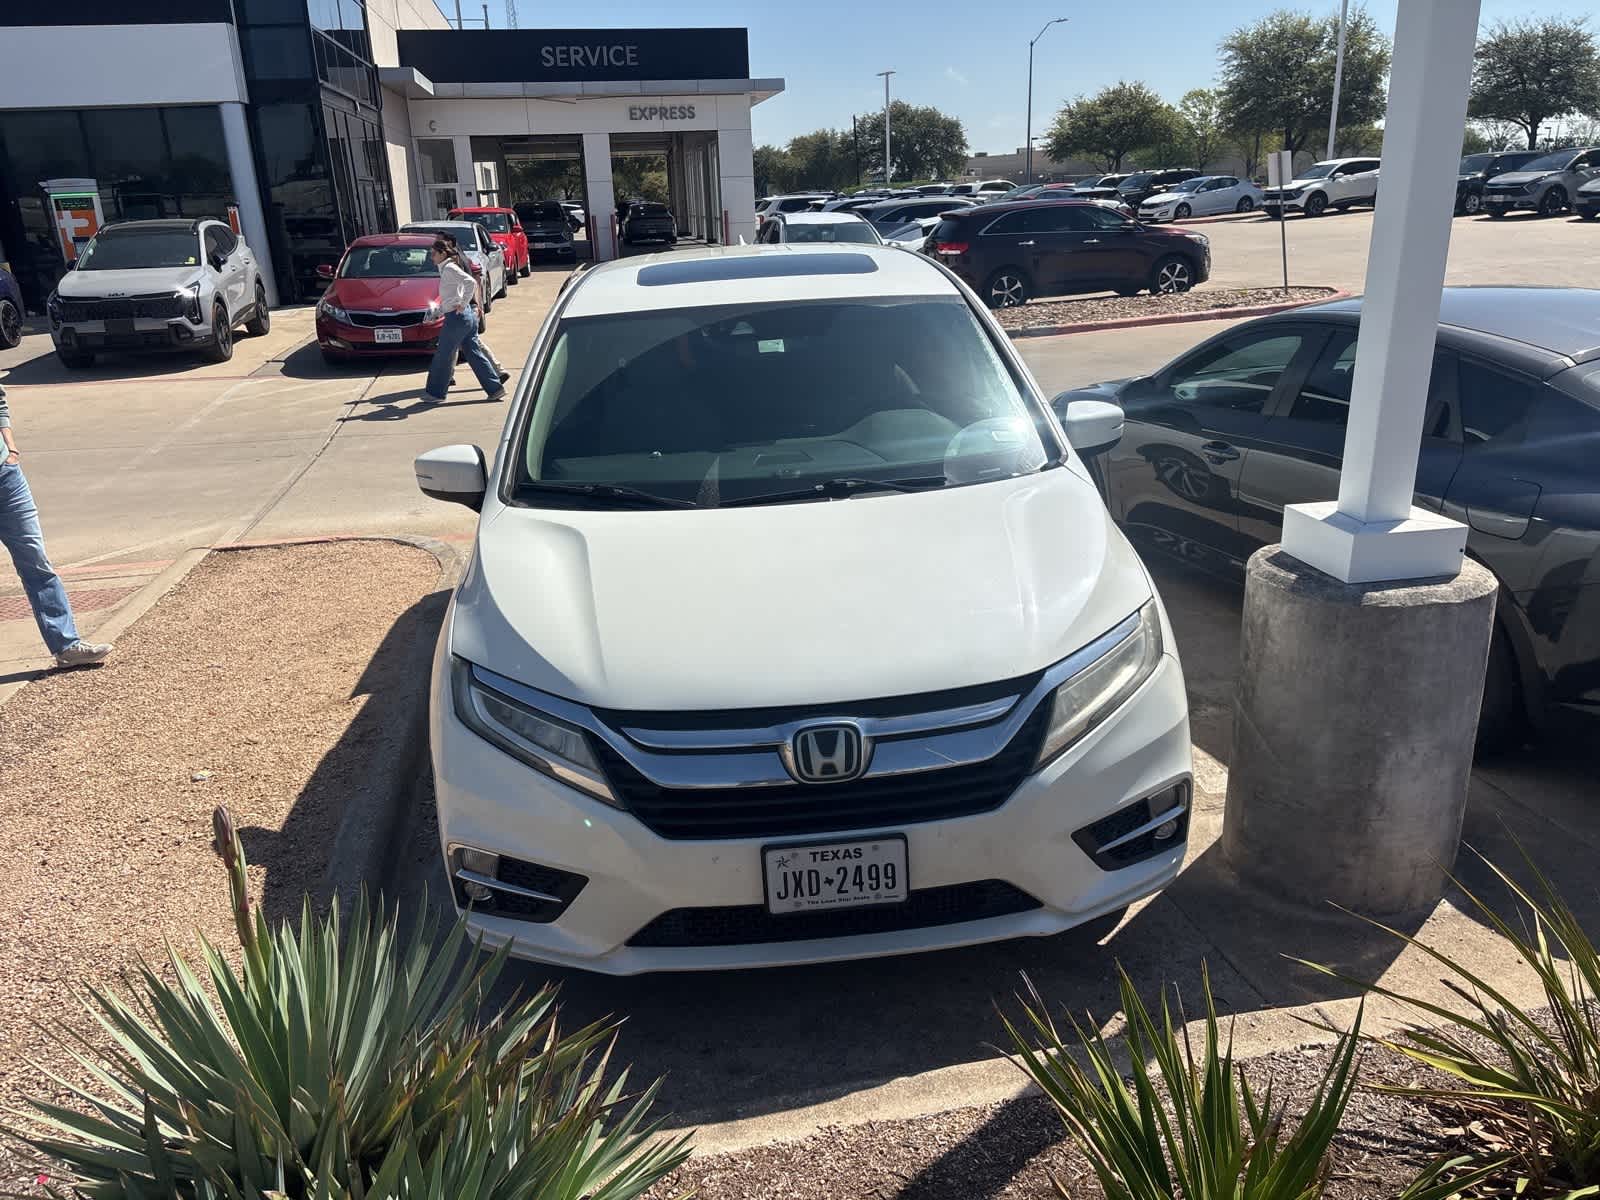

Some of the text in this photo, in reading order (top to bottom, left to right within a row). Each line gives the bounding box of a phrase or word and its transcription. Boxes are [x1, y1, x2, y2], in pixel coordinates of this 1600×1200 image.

[540, 45, 640, 67] SERVICE
[629, 105, 696, 121] EXPRESS
[809, 847, 863, 863] TEXAS
[776, 862, 897, 900] JXD 2499
